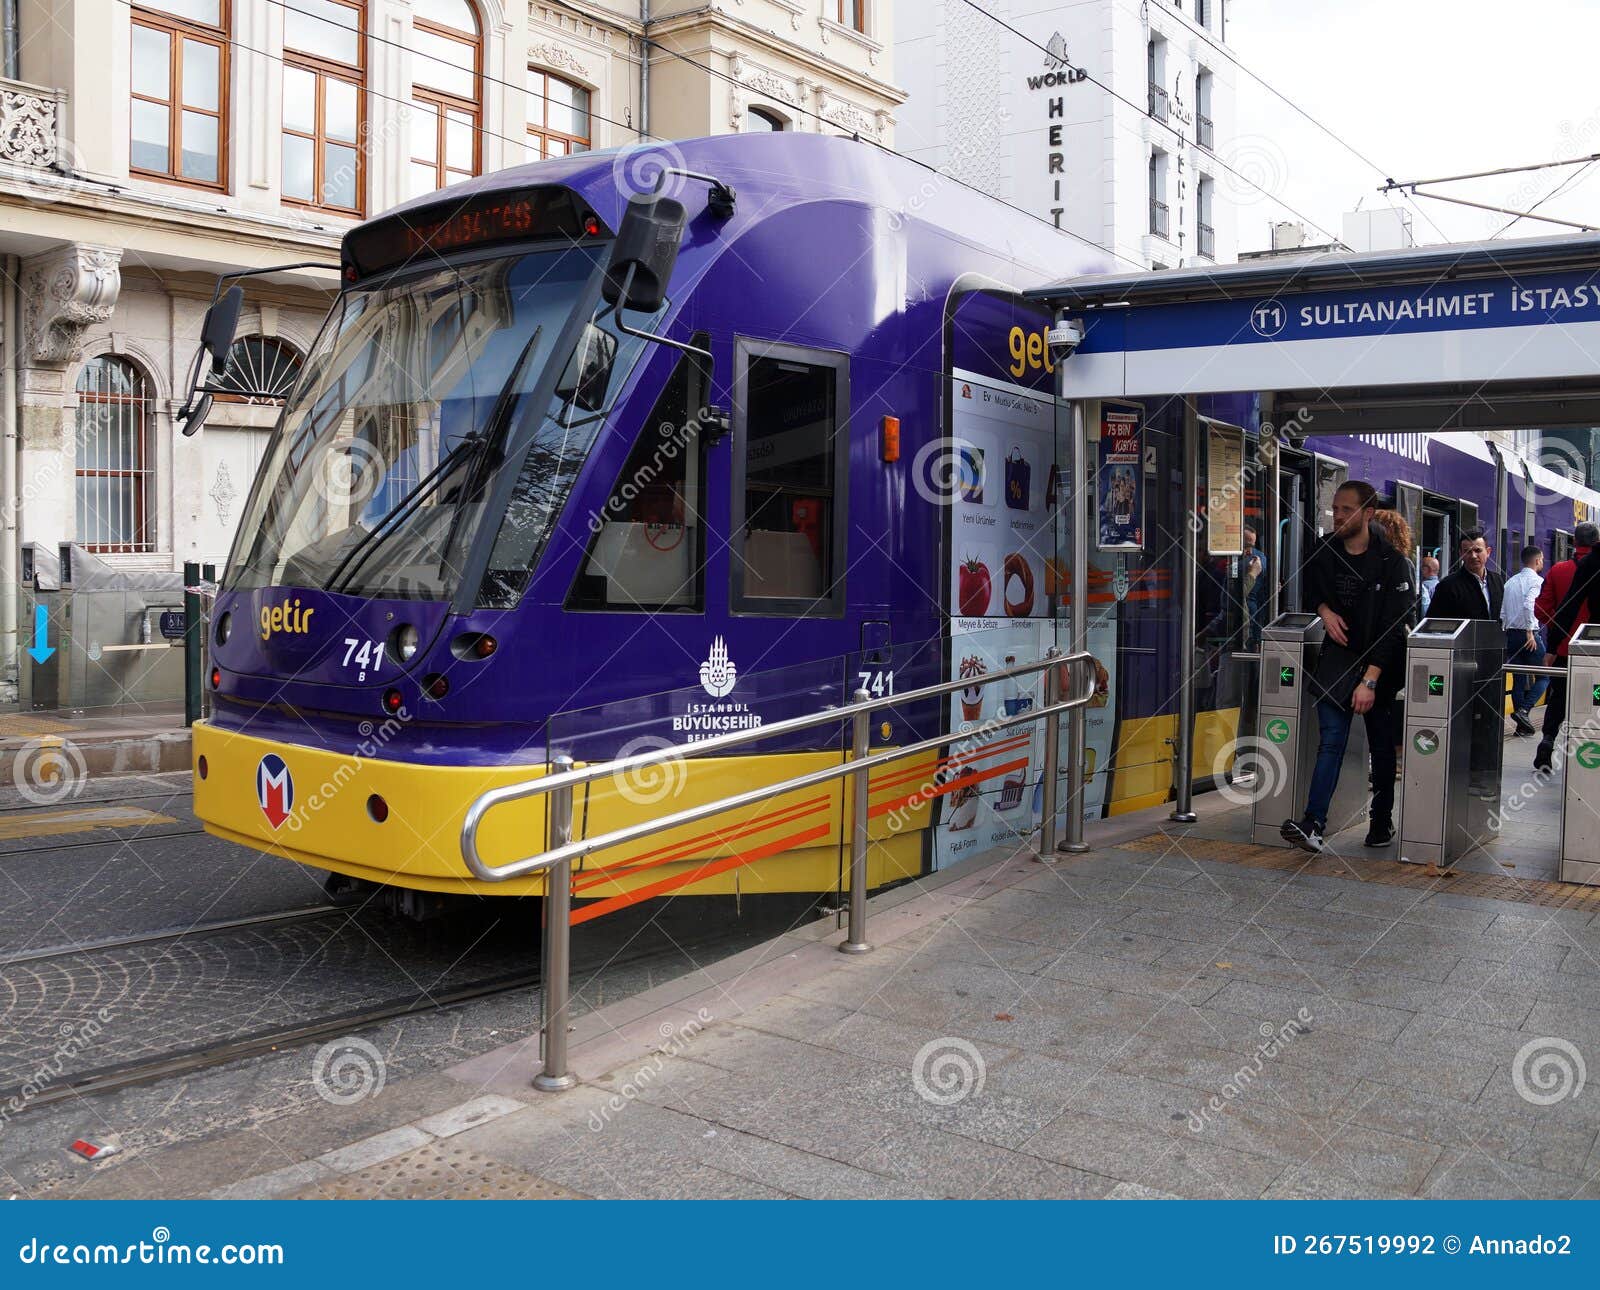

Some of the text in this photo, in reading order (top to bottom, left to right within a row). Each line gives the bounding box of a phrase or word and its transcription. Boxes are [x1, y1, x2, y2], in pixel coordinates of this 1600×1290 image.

[1027, 68, 1087, 90] WORLD
[1255, 308, 1281, 329] T1
[1300, 292, 1494, 327] SULTANAHMET
[1009, 326, 1054, 377] get
[260, 599, 314, 640] getir
[342, 638, 385, 671] 741
[358, 672, 366, 682] B
[858, 671, 894, 697] 741
[687, 703, 749, 713] İSTANBUL
[673, 713, 762, 731] BÜYÜKŞEHİR
